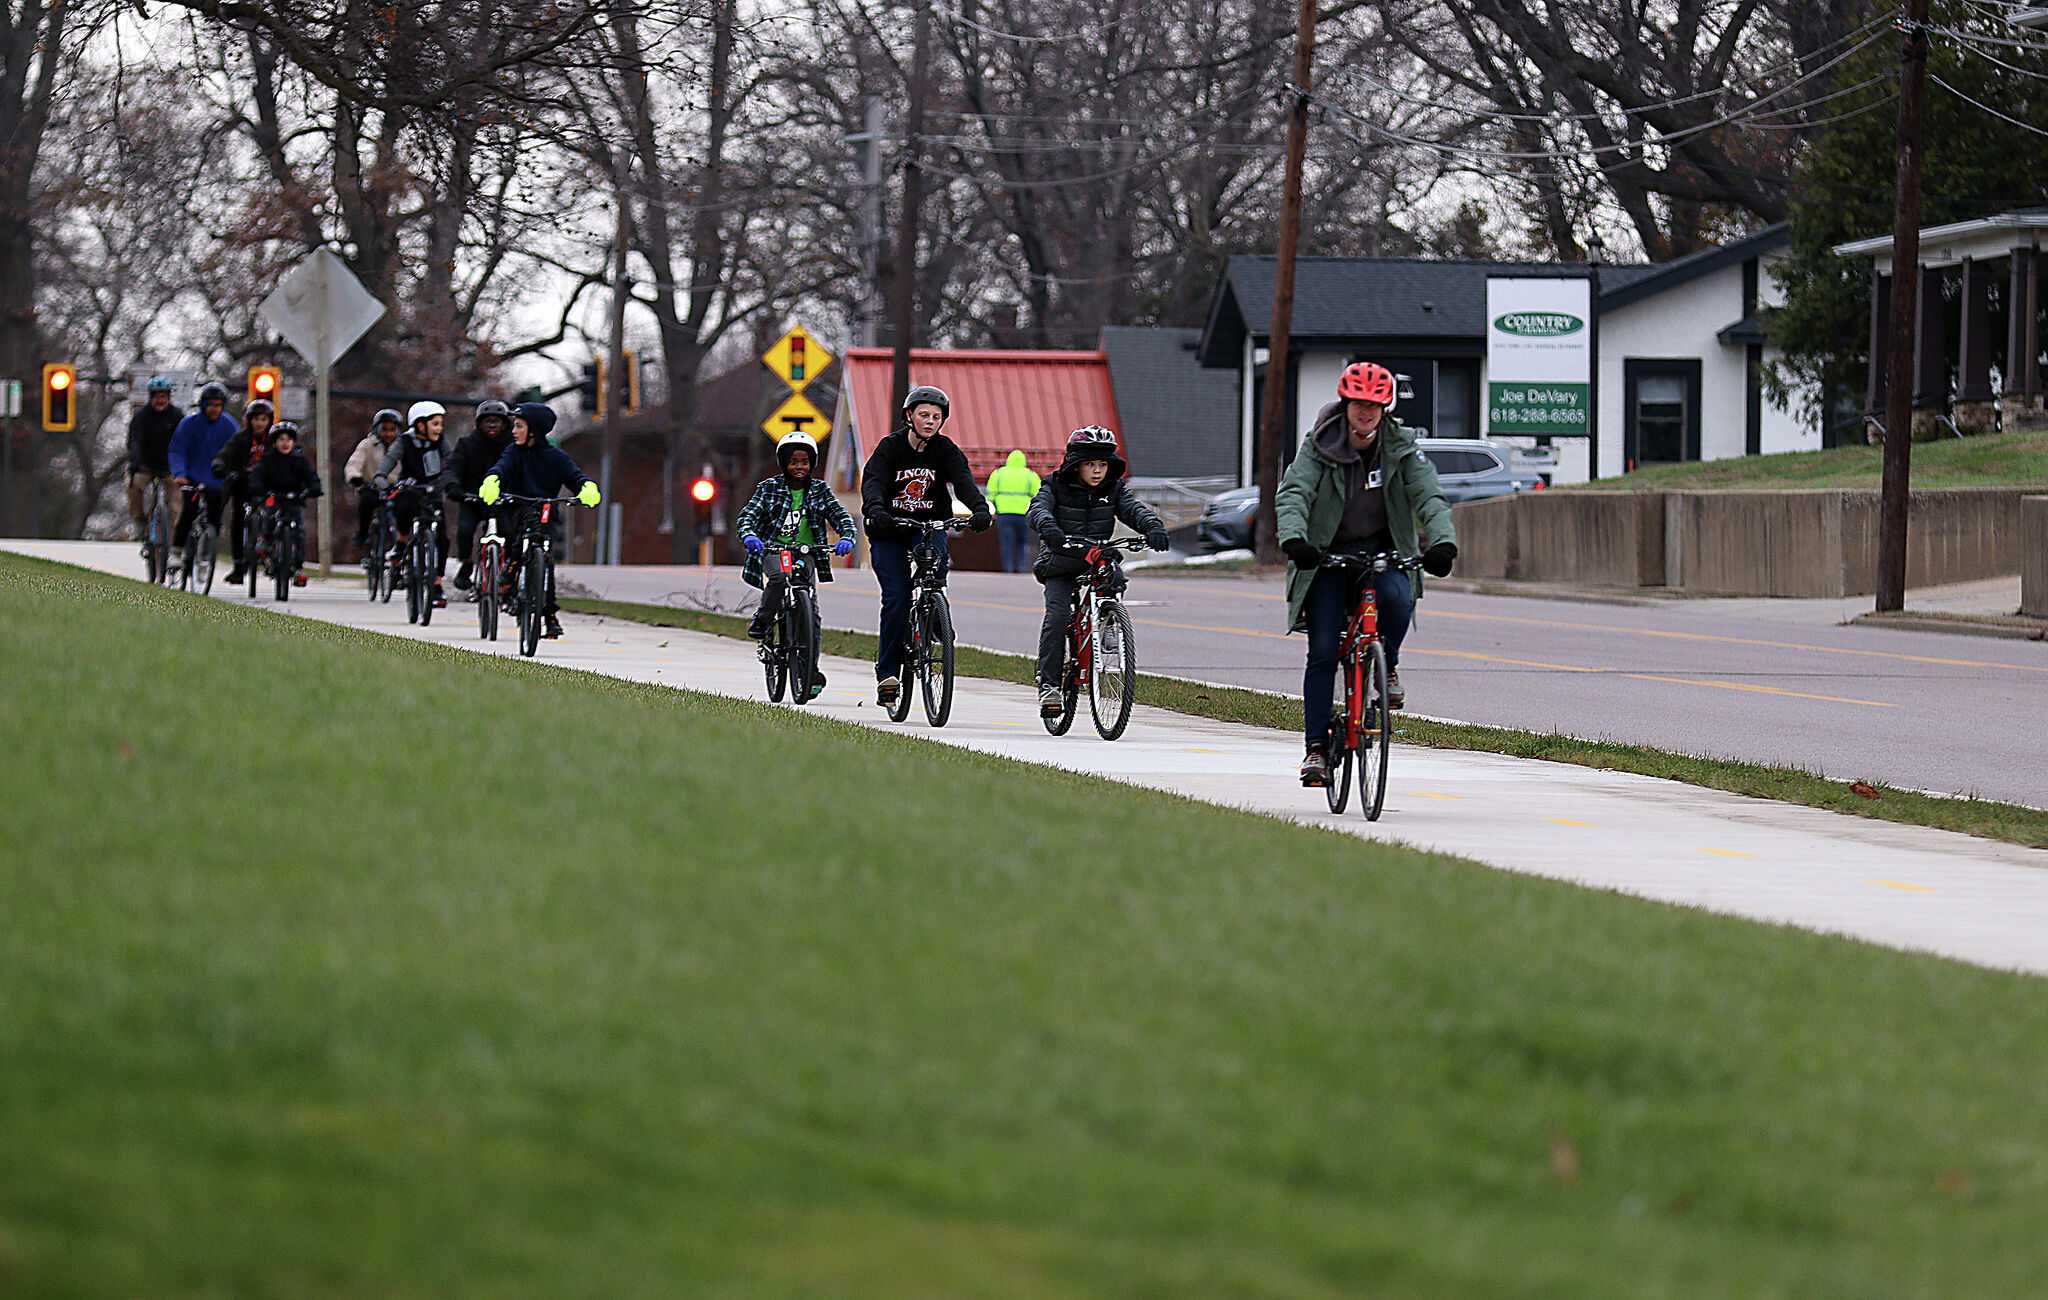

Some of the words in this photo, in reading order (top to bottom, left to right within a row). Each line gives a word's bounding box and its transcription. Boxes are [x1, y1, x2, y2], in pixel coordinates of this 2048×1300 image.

[1504, 315, 1573, 329] COUNTRY
[1499, 389, 1525, 404] Joe
[1528, 389, 1578, 407] DeVary
